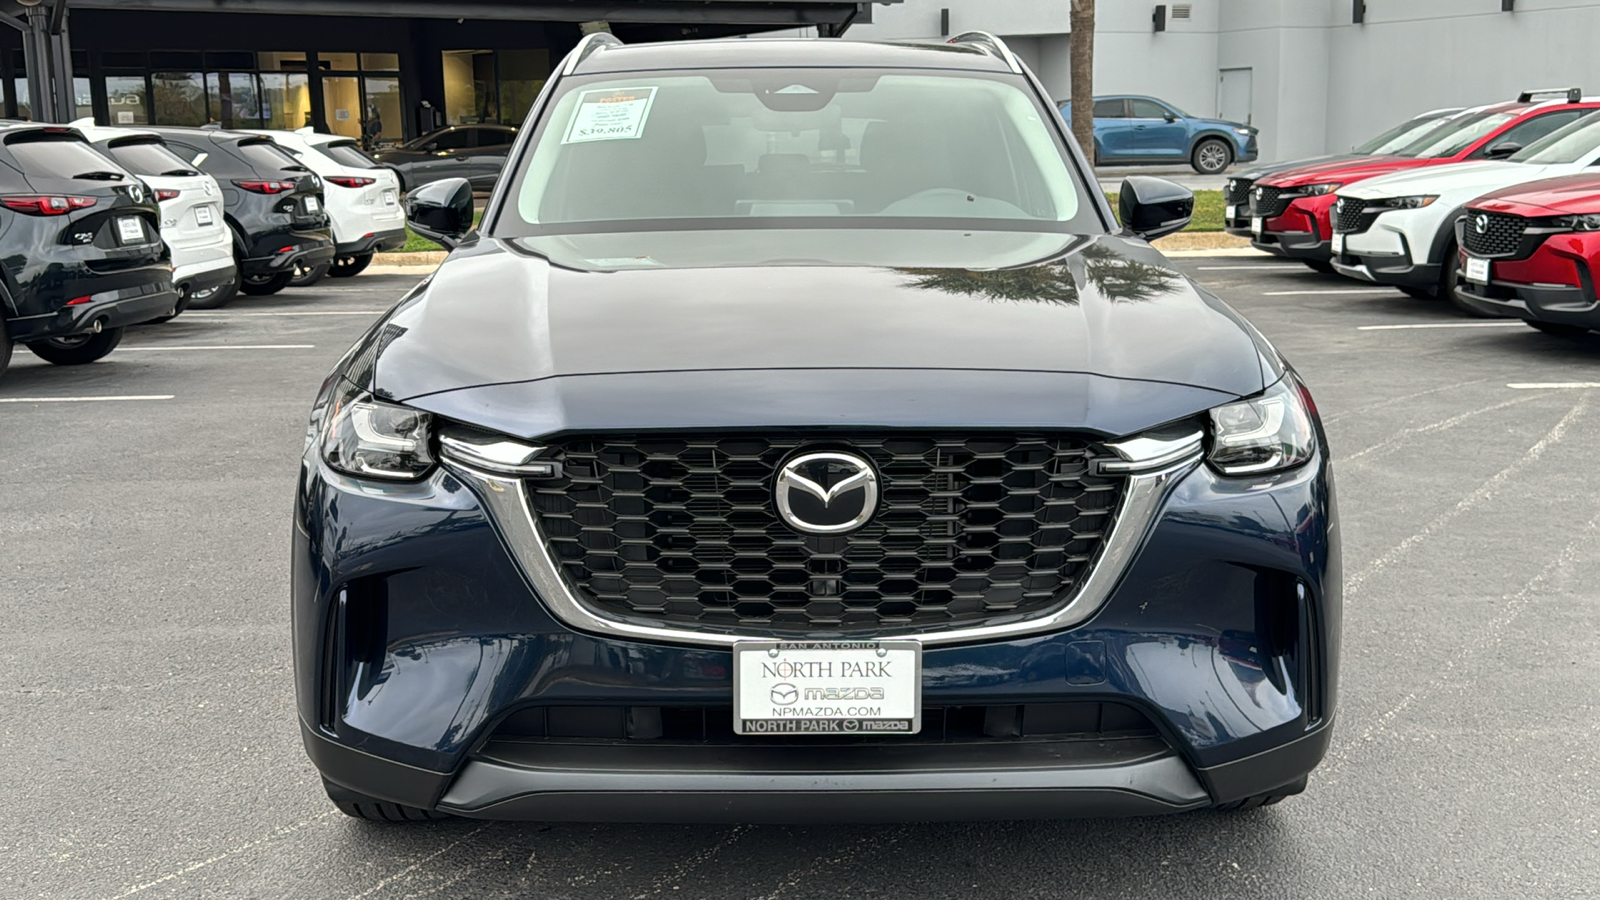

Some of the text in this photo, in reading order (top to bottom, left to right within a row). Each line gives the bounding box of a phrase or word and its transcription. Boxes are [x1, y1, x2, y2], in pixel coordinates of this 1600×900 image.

[761, 661, 892, 678] NORTH PARK
[804, 687, 885, 700] mazda
[772, 706, 881, 717] NPMAZDA.COM
[745, 720, 909, 732] NORTH PARK mazda
